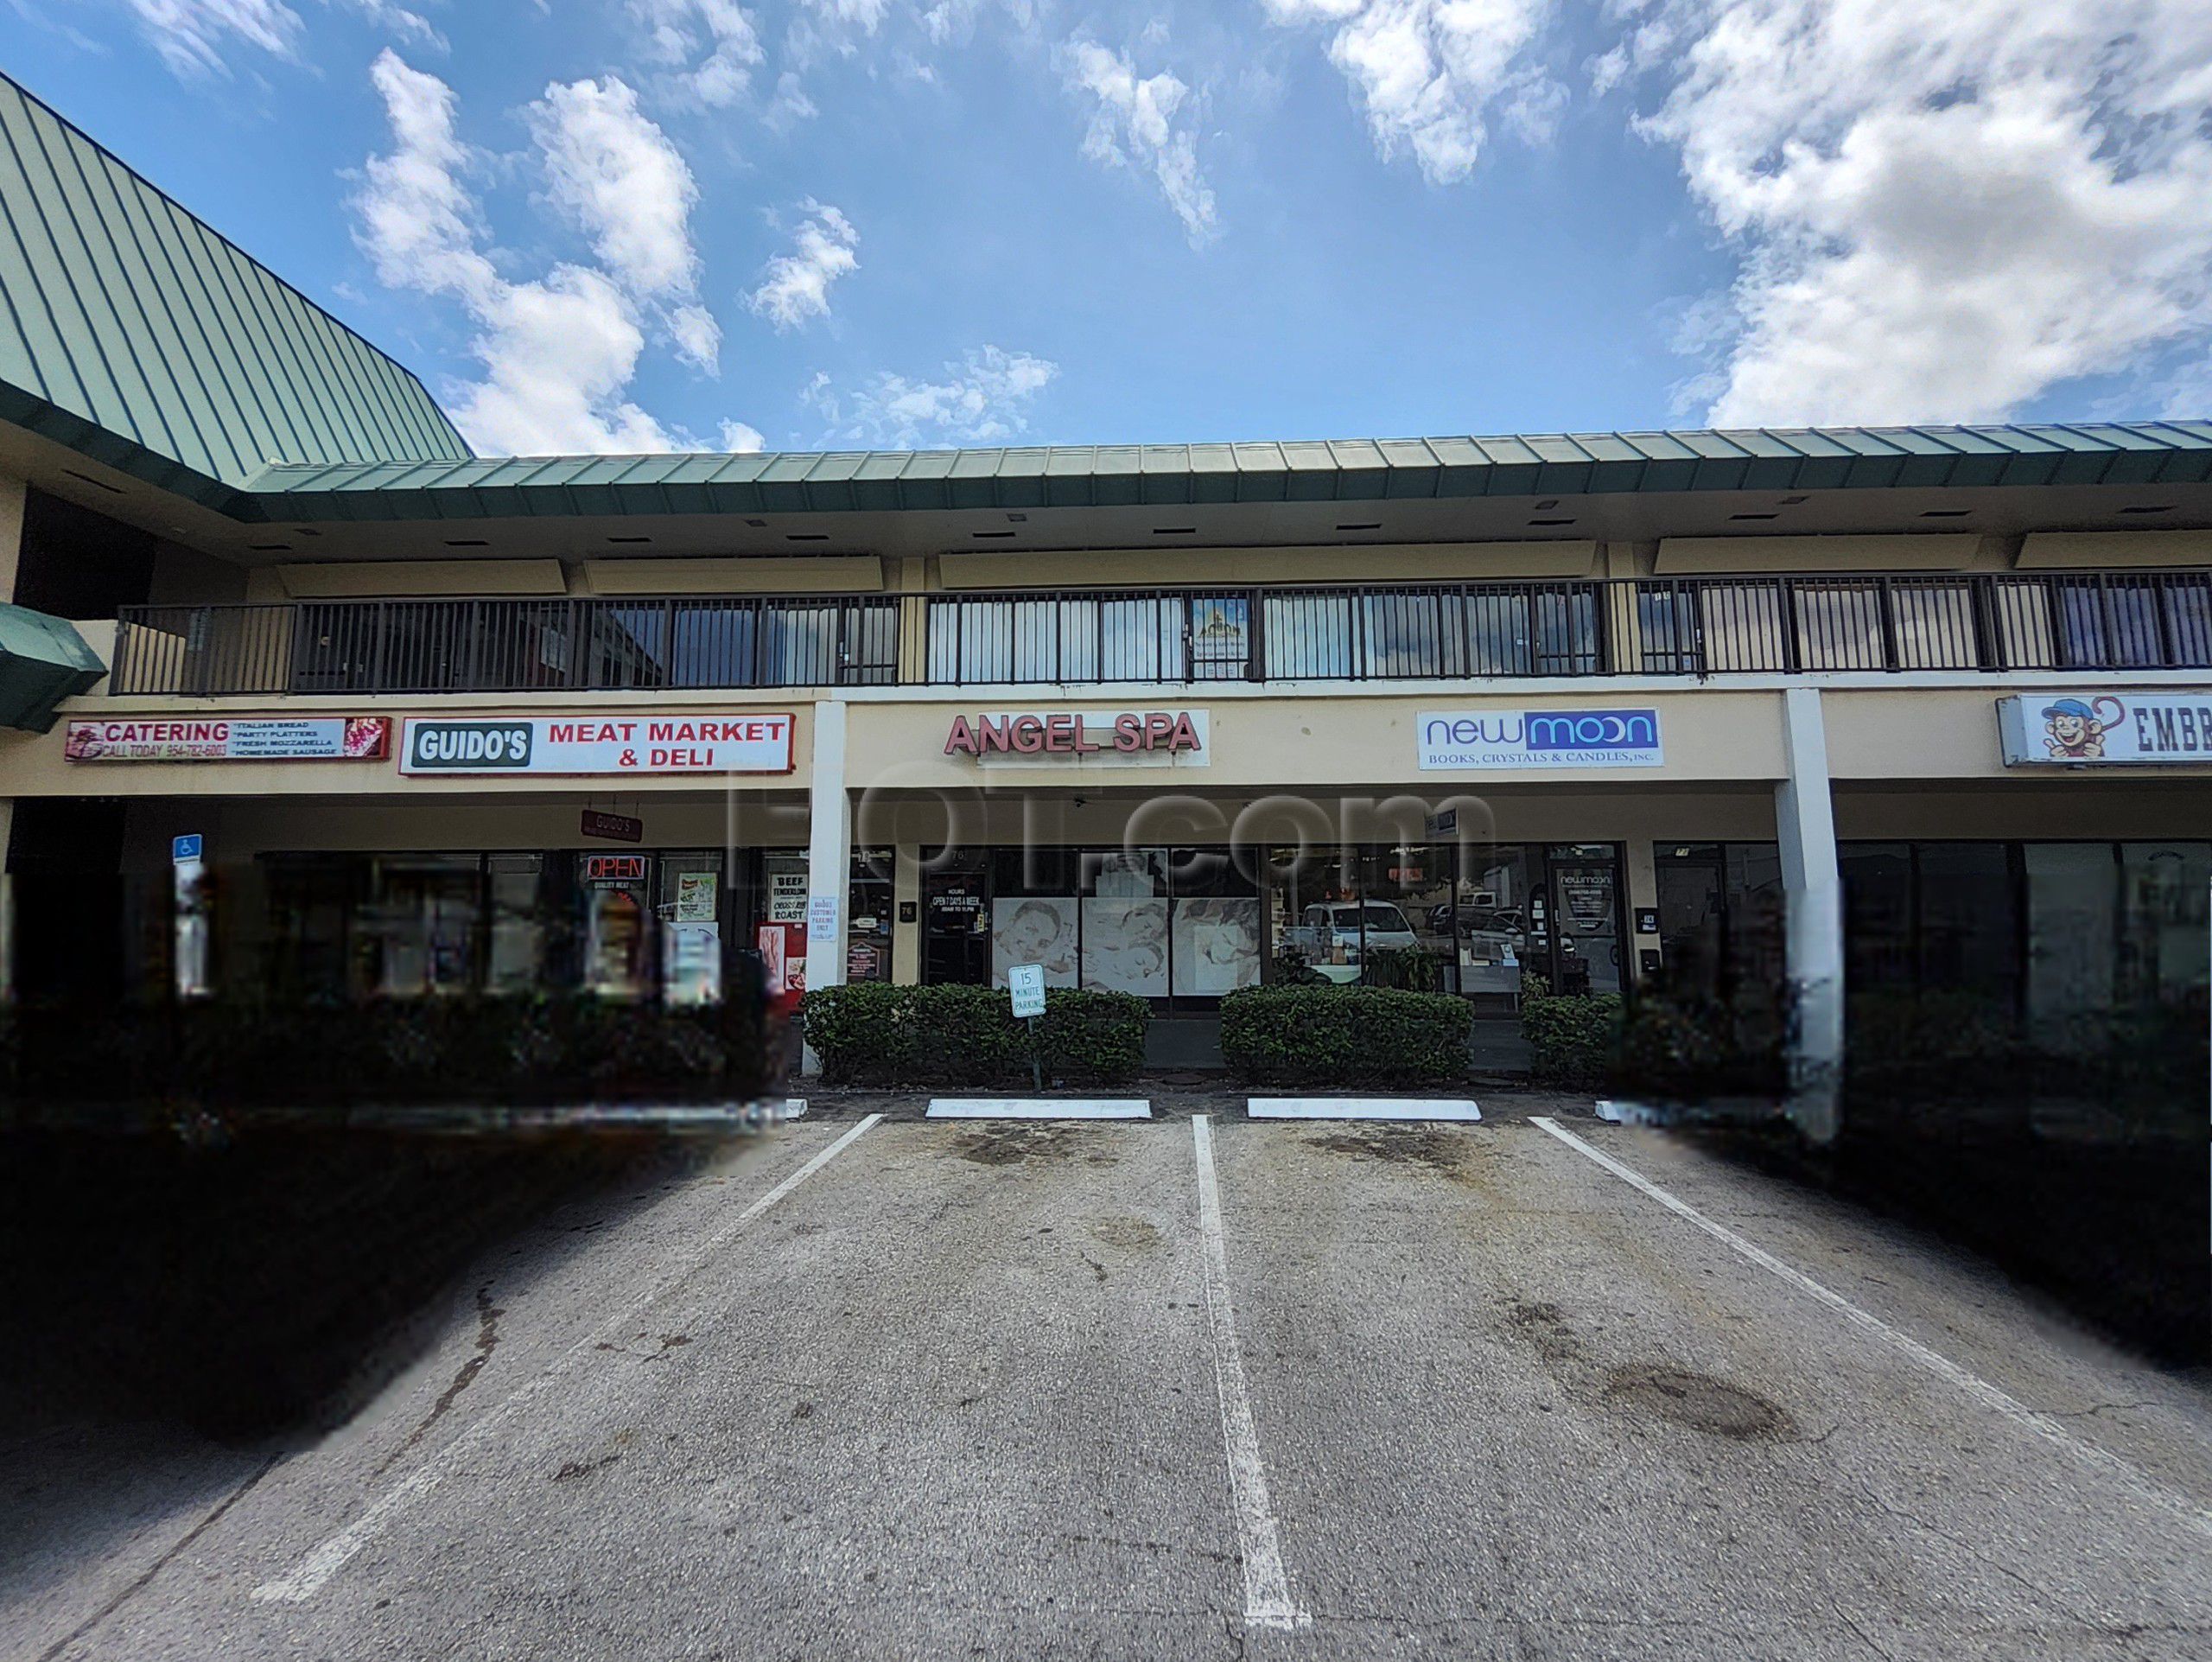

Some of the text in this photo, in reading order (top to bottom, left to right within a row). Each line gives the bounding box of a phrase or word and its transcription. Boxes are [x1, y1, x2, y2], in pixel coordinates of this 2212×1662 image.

[105, 722, 229, 742] CATERING
[549, 722, 785, 743] MEAT MARKET
[944, 711, 1202, 755] ANGEL SPA
[2133, 707, 2212, 752] EMBR
[103, 744, 127, 757] CALL
[130, 744, 163, 757] TODAY
[419, 729, 527, 761] GUIDO'S
[619, 748, 714, 767] & DELI
[1429, 754, 1478, 765] BOOKS,
[1482, 753, 1548, 763] CRYSTALS
[1551, 753, 1562, 762] &
[1566, 752, 1633, 763] CANDLES,
[588, 856, 642, 877] OPEN
[777, 876, 804, 887] BEEF
[932, 896, 945, 906] OPEN
[950, 896, 962, 906] DAYS
[966, 896, 980, 906] WEEK
[775, 910, 804, 920] ROAST
[1020, 972, 1032, 984] 15
[1014, 985, 1040, 997] MINUTE
[1014, 998, 1043, 1010] PARKING
